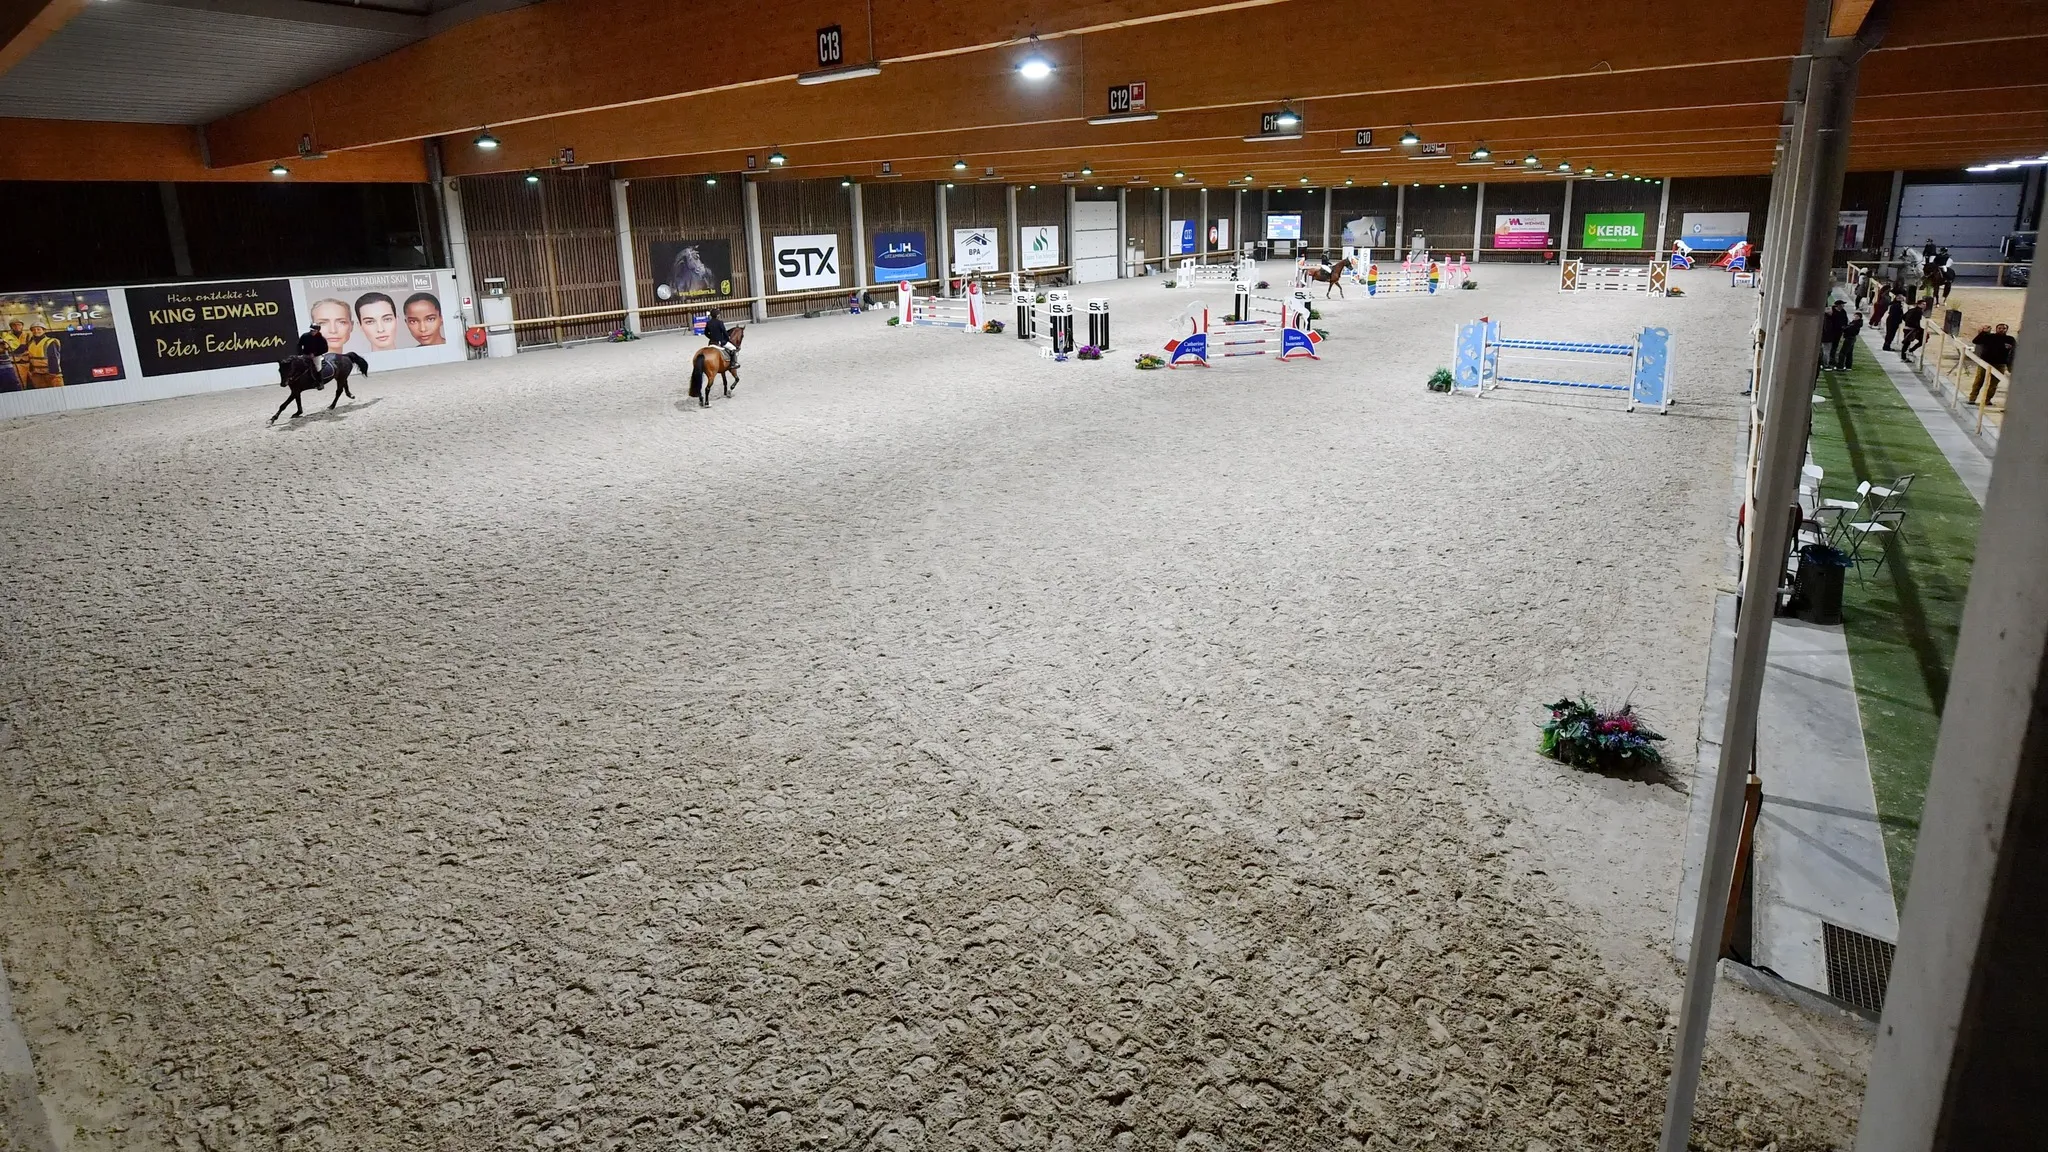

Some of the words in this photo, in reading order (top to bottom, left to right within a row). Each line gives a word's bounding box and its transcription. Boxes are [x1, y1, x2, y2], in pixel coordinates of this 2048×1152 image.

[819, 31, 841, 63] C13
[1110, 89, 1128, 111] C12
[1357, 131, 1371, 145] C10
[1596, 225, 1639, 237] KERBL
[889, 242, 912, 253] LJH
[778, 246, 837, 278] STX
[309, 279, 330, 289] YOUR
[331, 277, 349, 287] RIDE
[350, 276, 359, 286] TO
[360, 274, 389, 285] RADIANT
[391, 273, 408, 284] SKIN
[414, 278, 428, 286] Me
[167, 294, 192, 303] Hier
[196, 290, 243, 300] ontdekte
[246, 289, 258, 298] ik
[52, 310, 102, 322] SPIE
[149, 307, 196, 325] KING
[202, 301, 279, 321] EDWARD
[156, 338, 200, 358] Peter
[206, 332, 287, 353] Eeckman
